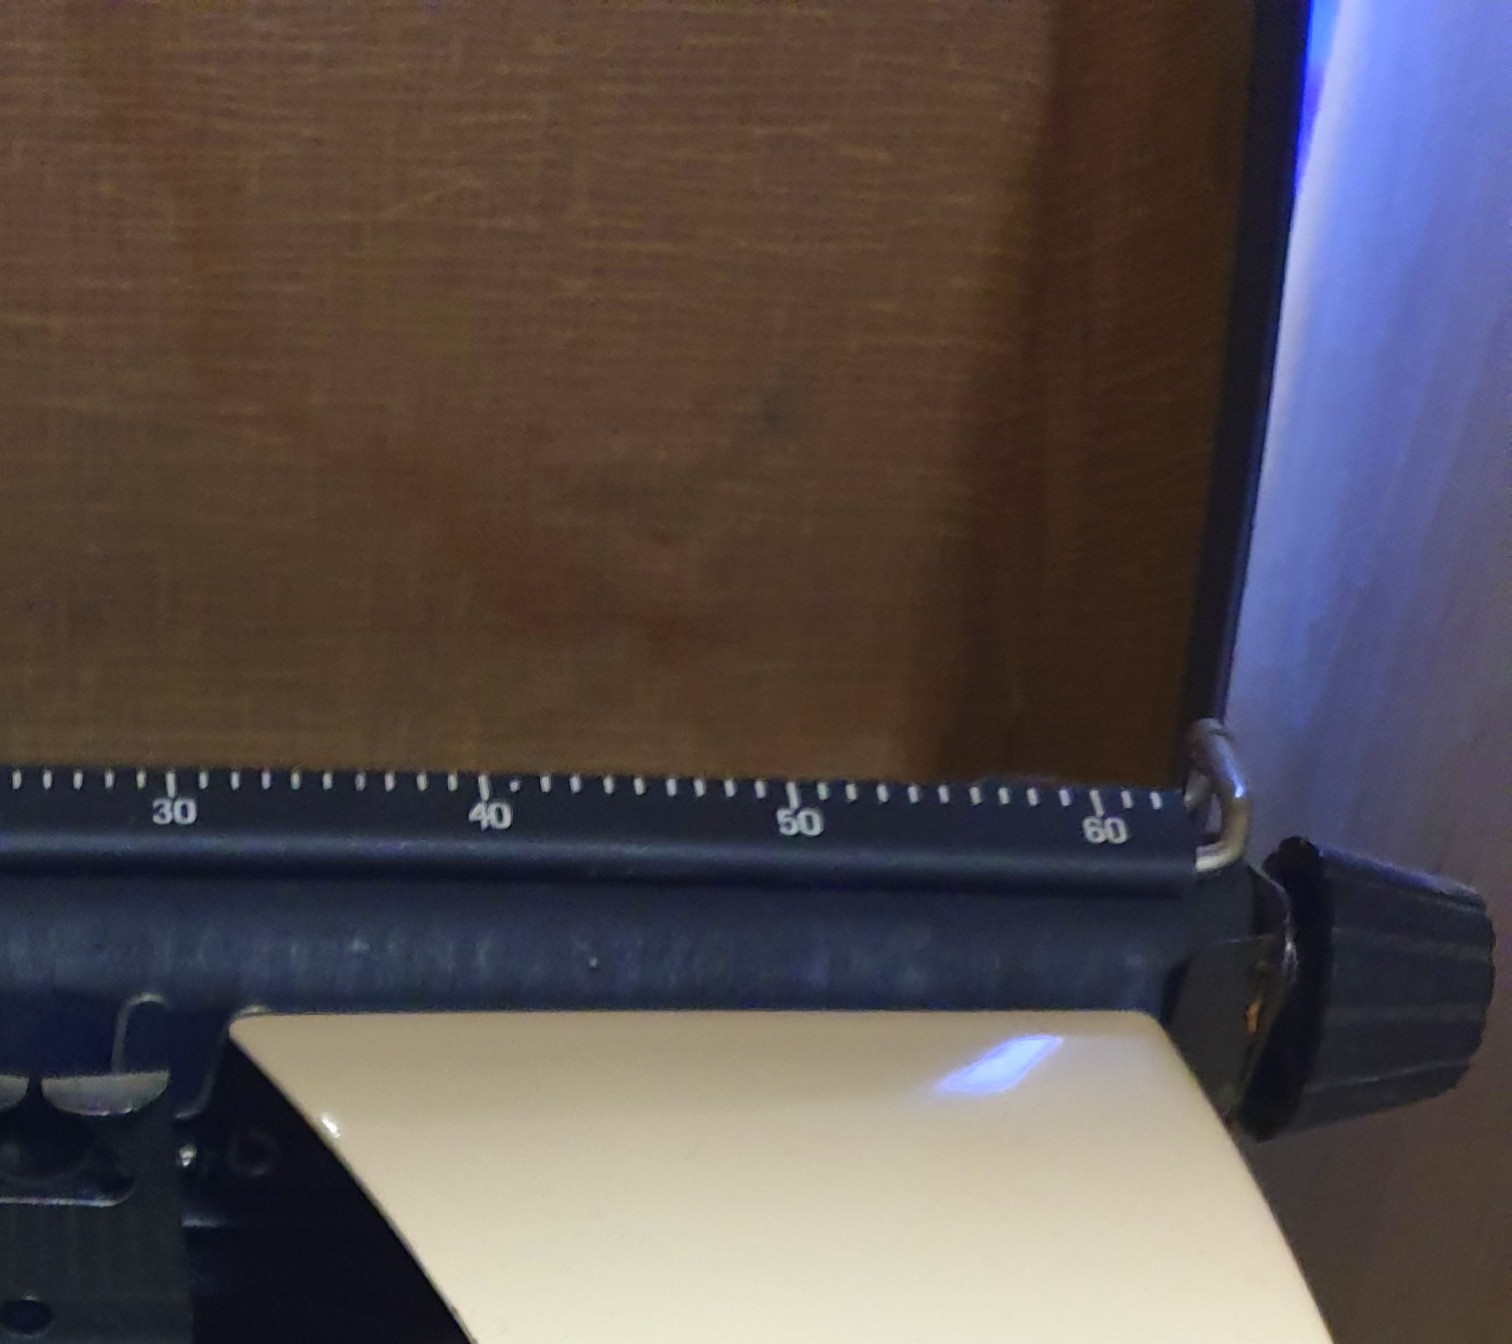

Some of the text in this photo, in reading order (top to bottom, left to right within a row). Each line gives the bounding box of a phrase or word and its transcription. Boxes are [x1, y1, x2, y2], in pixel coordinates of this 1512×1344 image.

[152, 798, 197, 825] 30
[468, 801, 512, 831] 40
[776, 809, 823, 837] 50
[1082, 815, 1129, 845] 60
